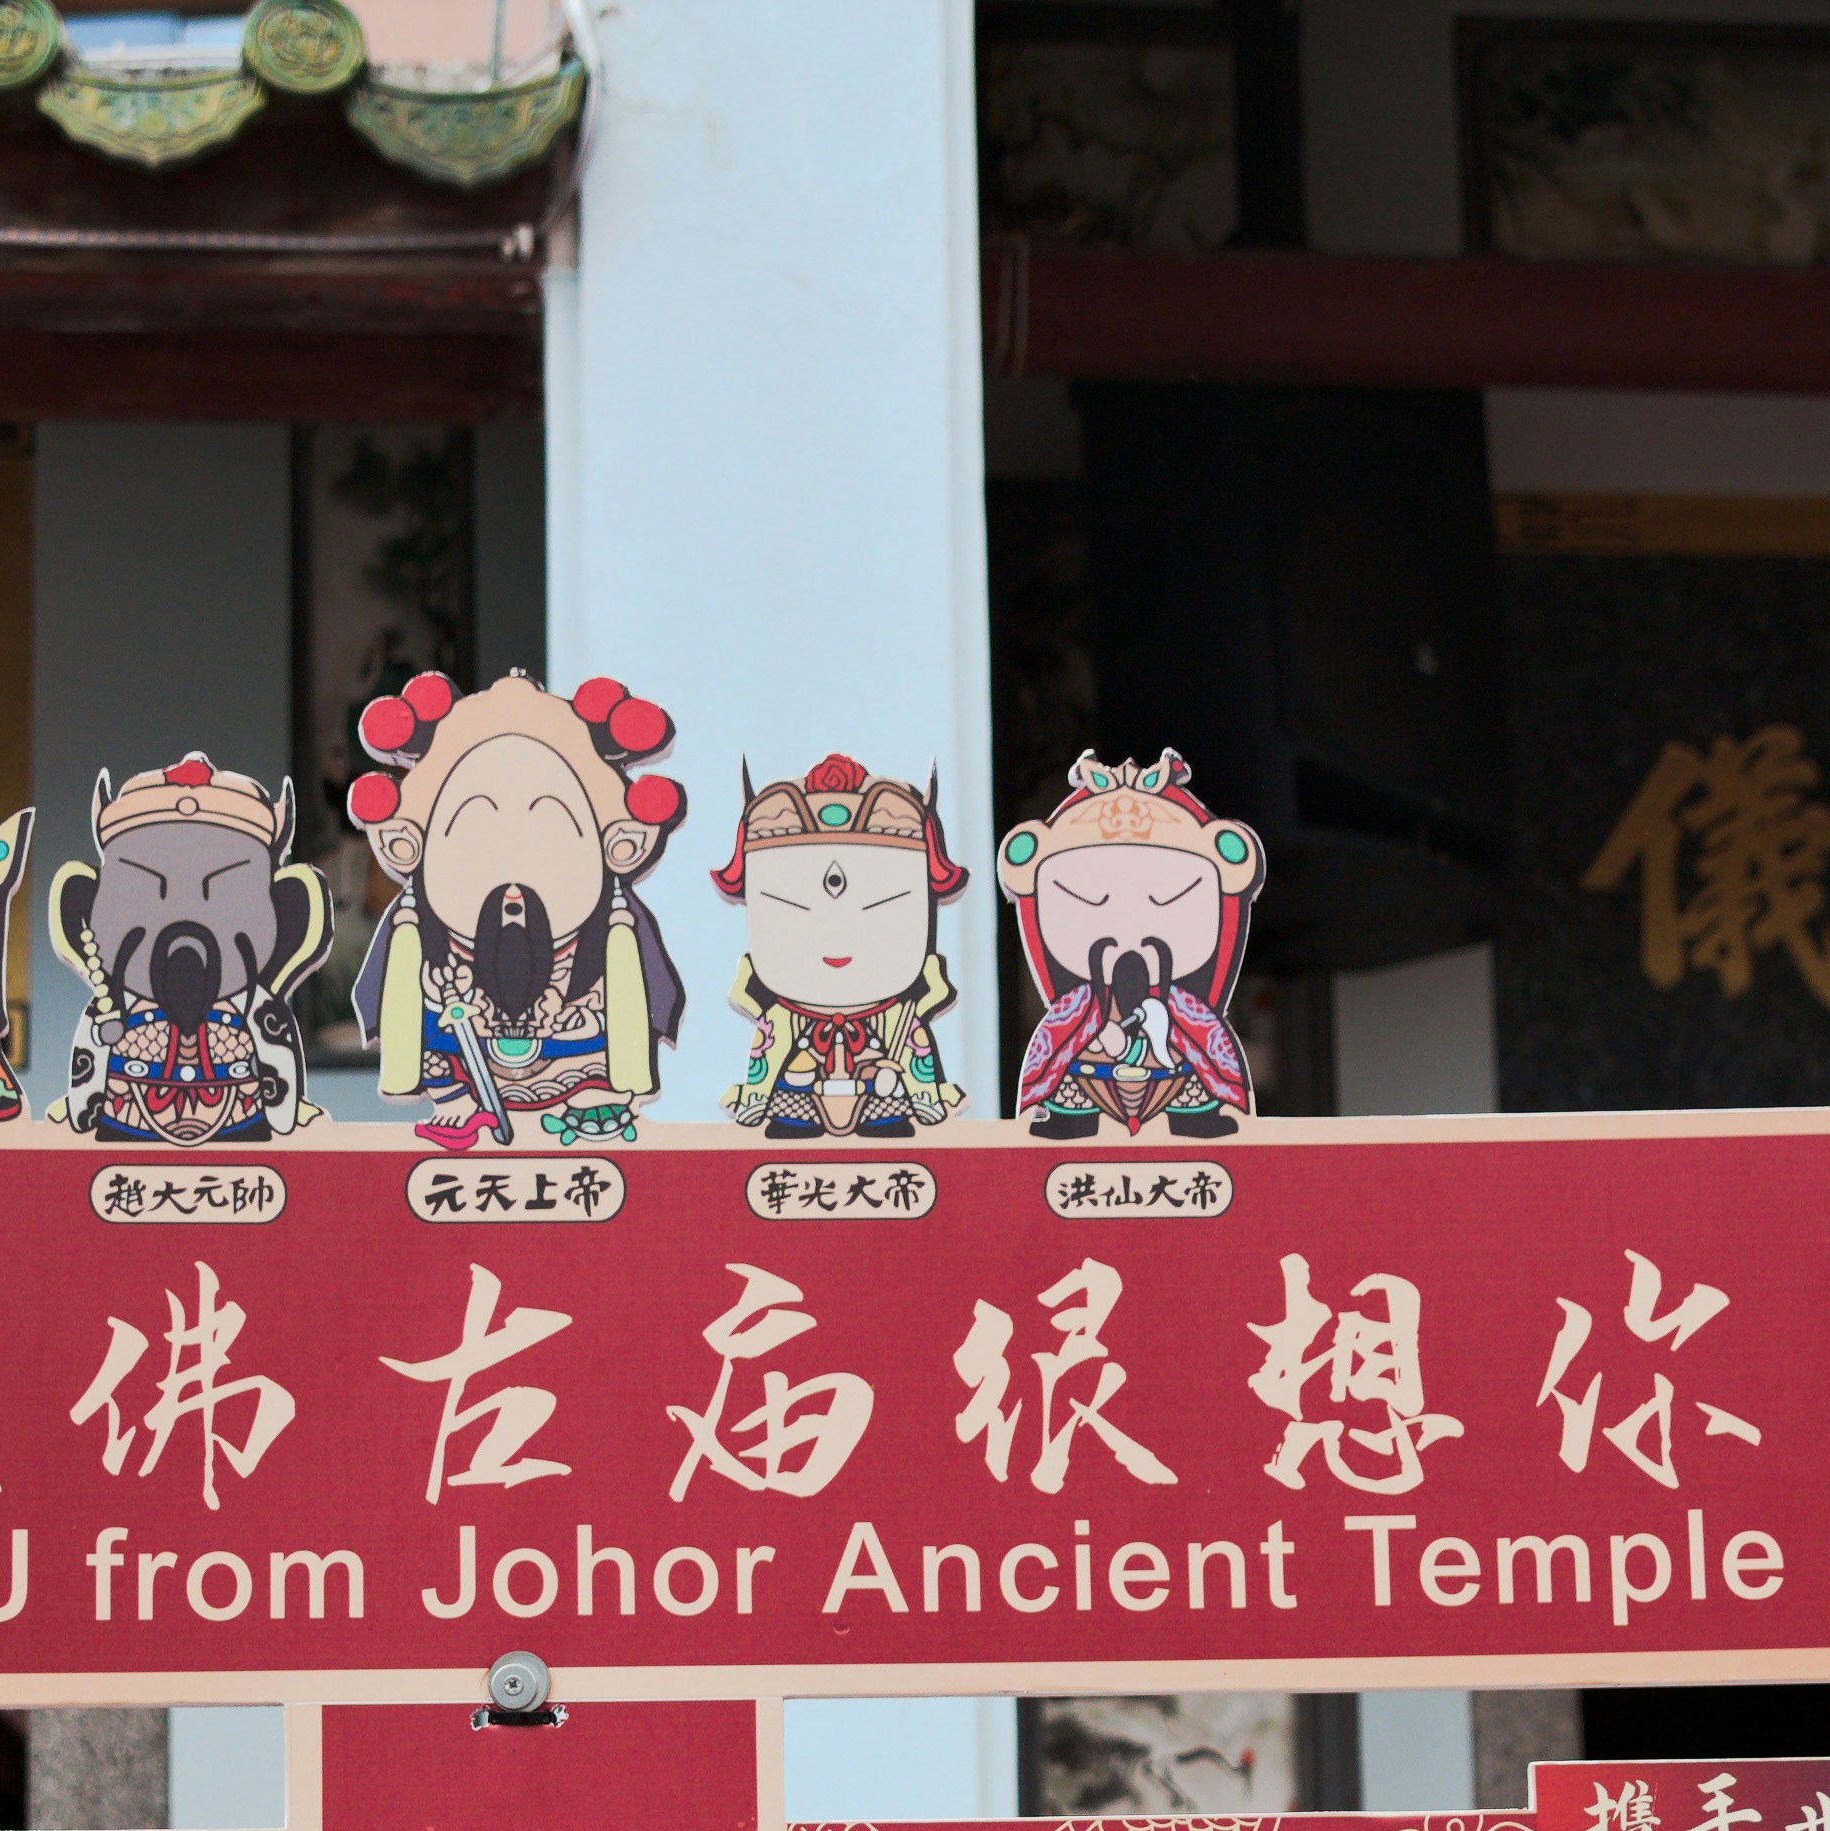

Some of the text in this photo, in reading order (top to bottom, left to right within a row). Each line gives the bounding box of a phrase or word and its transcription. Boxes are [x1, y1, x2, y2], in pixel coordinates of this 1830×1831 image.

[424, 1166, 612, 1217] 元天上帝
[1058, 1170, 1223, 1210] 洪仙大帝
[86, 1527, 364, 1621] from
[422, 1525, 776, 1619] Johor
[822, 1520, 1297, 1613] Ancient
[1345, 1509, 1784, 1626] Temple
